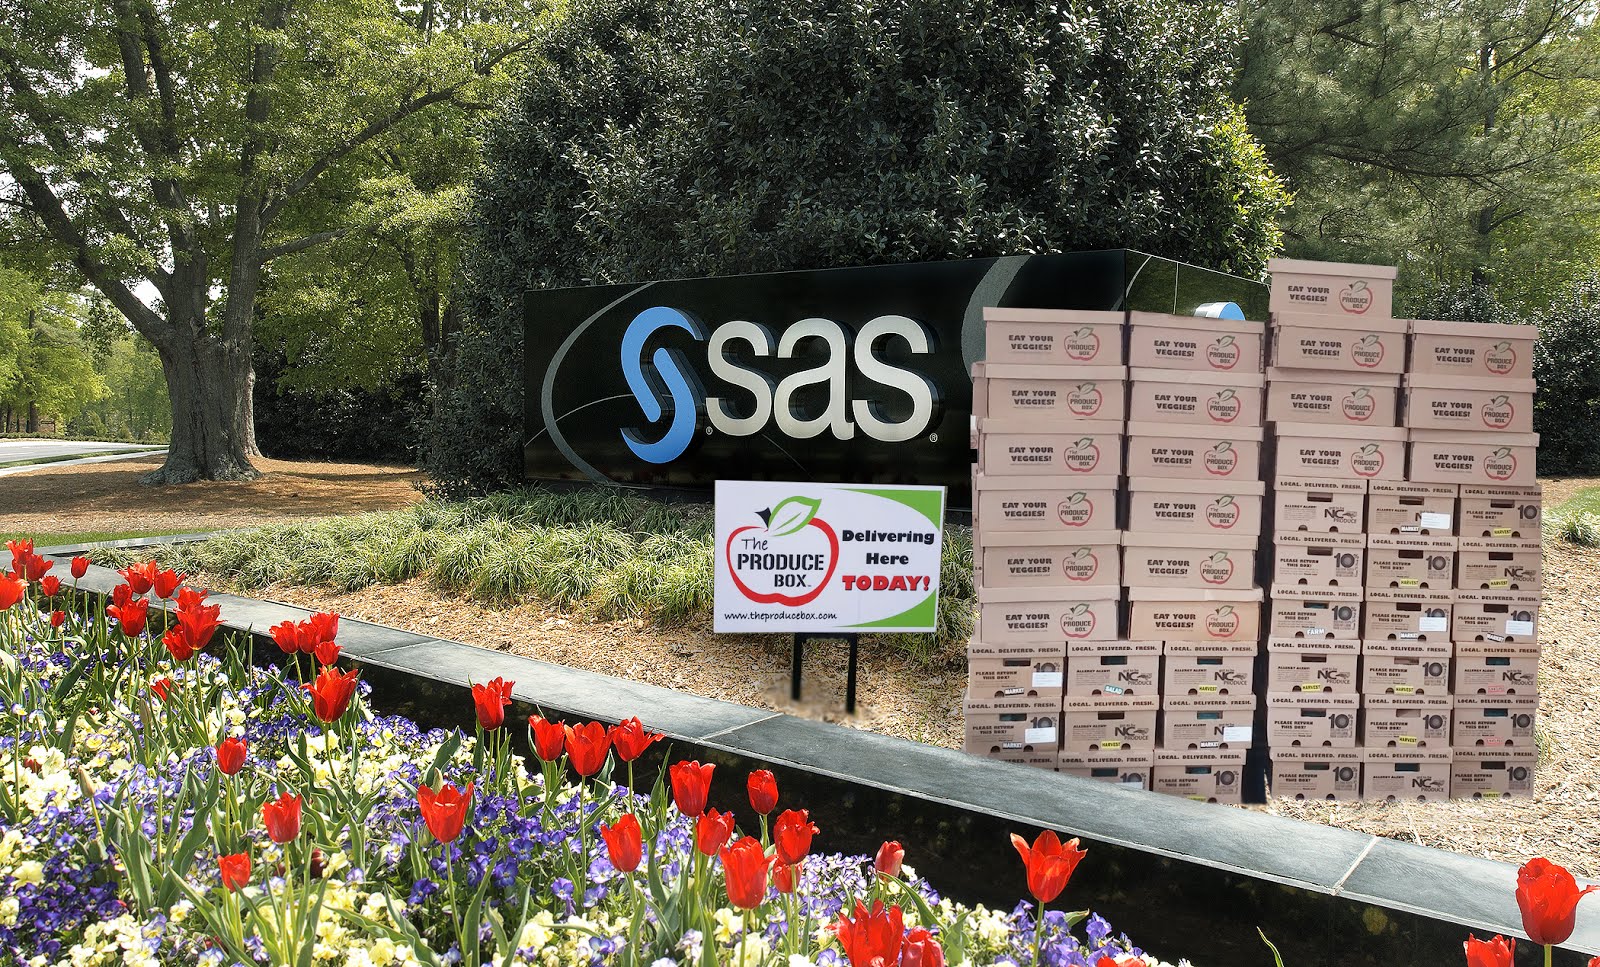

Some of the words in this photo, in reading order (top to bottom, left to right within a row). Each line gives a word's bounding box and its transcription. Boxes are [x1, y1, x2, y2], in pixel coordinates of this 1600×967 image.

[1156, 347, 1194, 356] VEGGIES!
[1293, 400, 1330, 409] VEGGIES!
[1324, 509, 1344, 518] NC
[842, 530, 934, 544] Delivering
[742, 537, 768, 550] The
[737, 554, 824, 570] PRODUCE
[866, 553, 909, 564] Here
[774, 574, 807, 587] BOX
[842, 575, 930, 591] TODAY!
[724, 612, 837, 622] www.theproducebox.com
[1118, 672, 1138, 681] NC
[1215, 672, 1234, 680] NC
[1318, 670, 1336, 679] NC
[1502, 672, 1521, 680] NC
